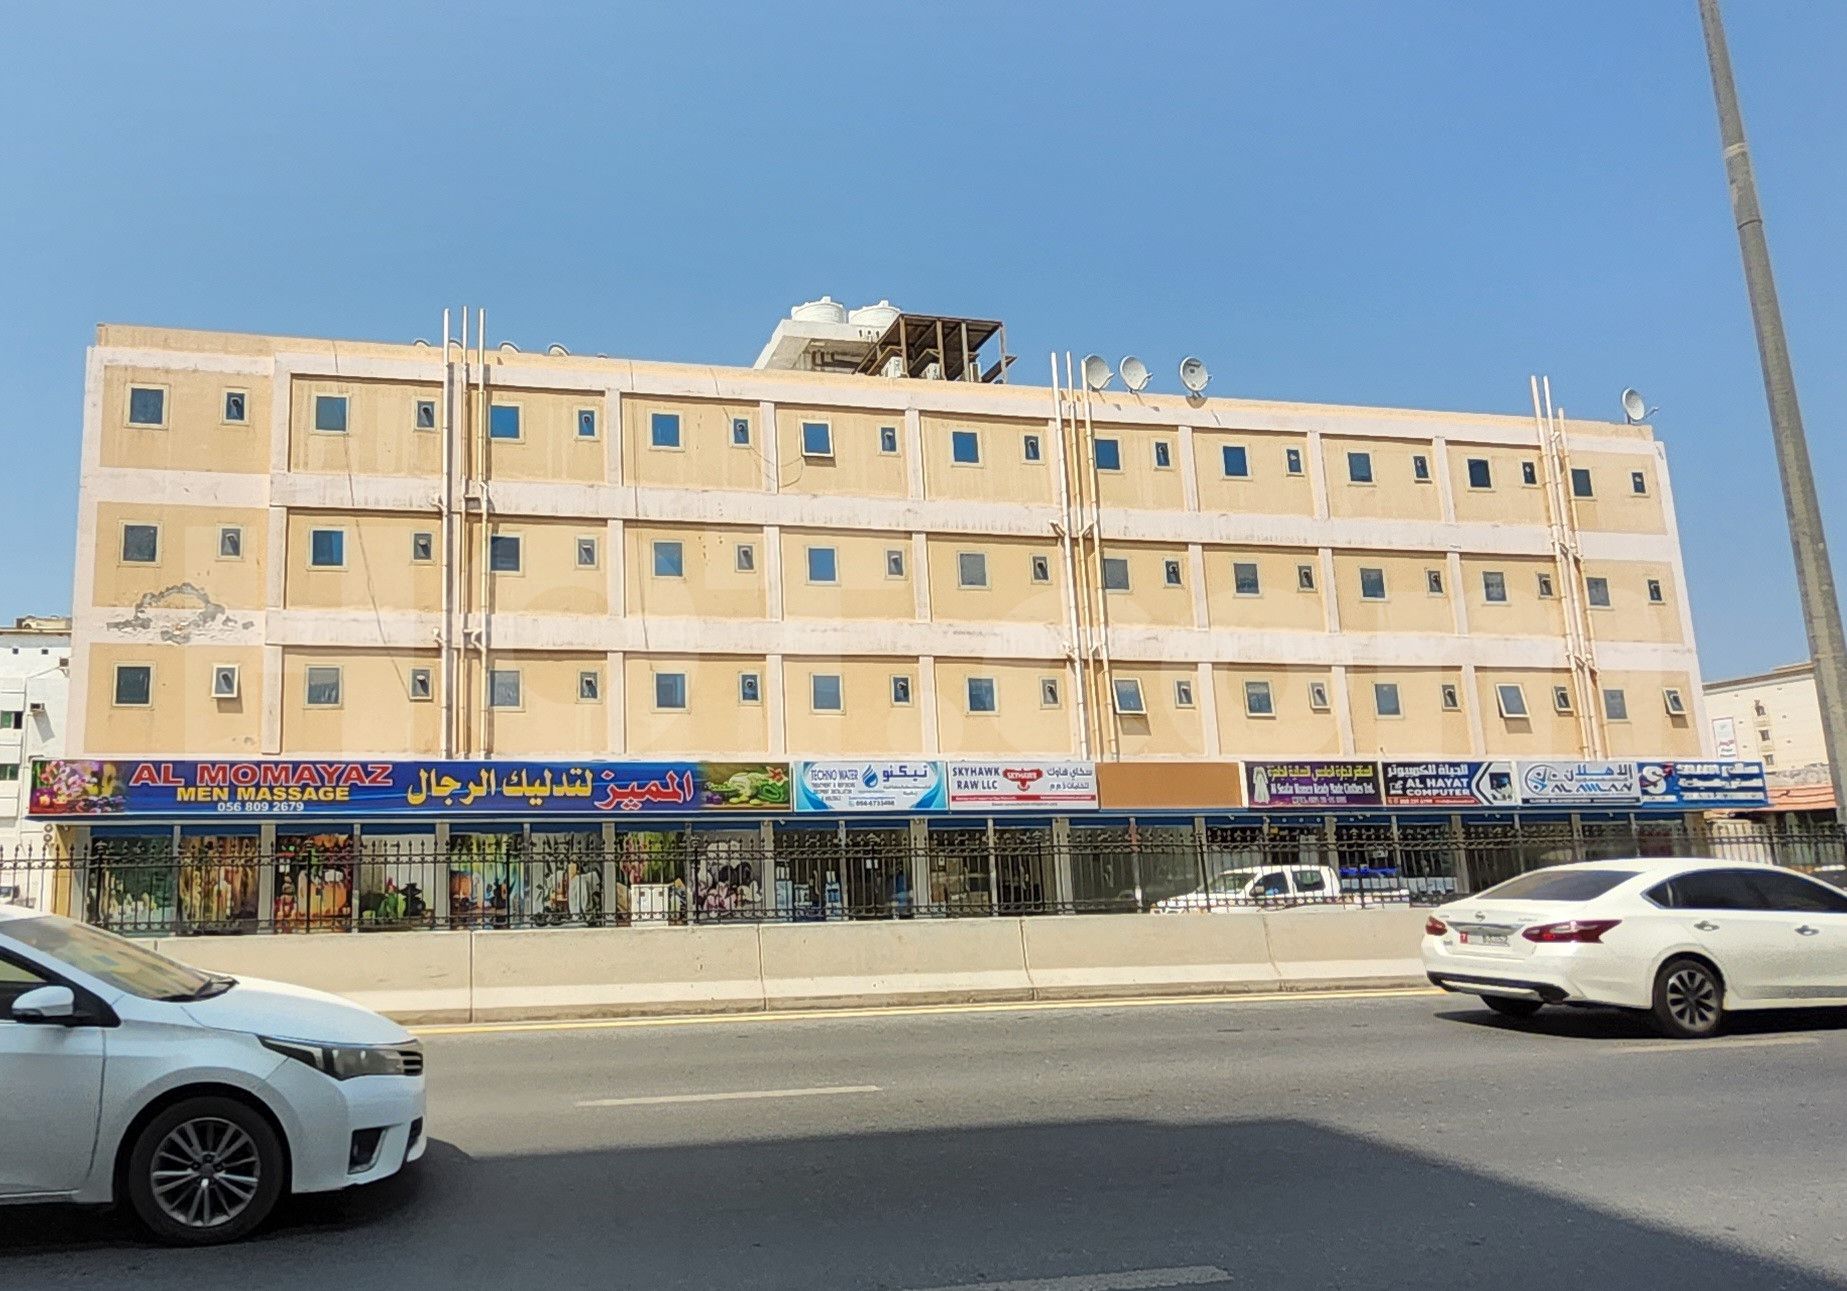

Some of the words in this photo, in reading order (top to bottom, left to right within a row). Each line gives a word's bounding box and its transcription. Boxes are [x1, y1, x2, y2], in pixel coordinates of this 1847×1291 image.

[129, 764, 185, 786] AL
[196, 764, 393, 786] MOMAYAZ
[811, 769, 837, 781] TECHNO
[839, 769, 859, 781] WATER
[952, 767, 1000, 777] SKYHAWK
[407, 768, 495, 805] الرجال
[502, 767, 593, 805] لتدليك
[595, 770, 694, 809] المميز
[957, 780, 979, 790] RAW
[981, 780, 998, 790] LLC
[1406, 779, 1424, 787] AL
[1426, 779, 1469, 788] HAYAT
[176, 787, 229, 801] MEN
[236, 787, 350, 801] MASSAGE
[1406, 788, 1470, 796] COMPUTER
[217, 802, 242, 812] 056
[245, 802, 269, 812] 809
[272, 802, 304, 812] 2679
